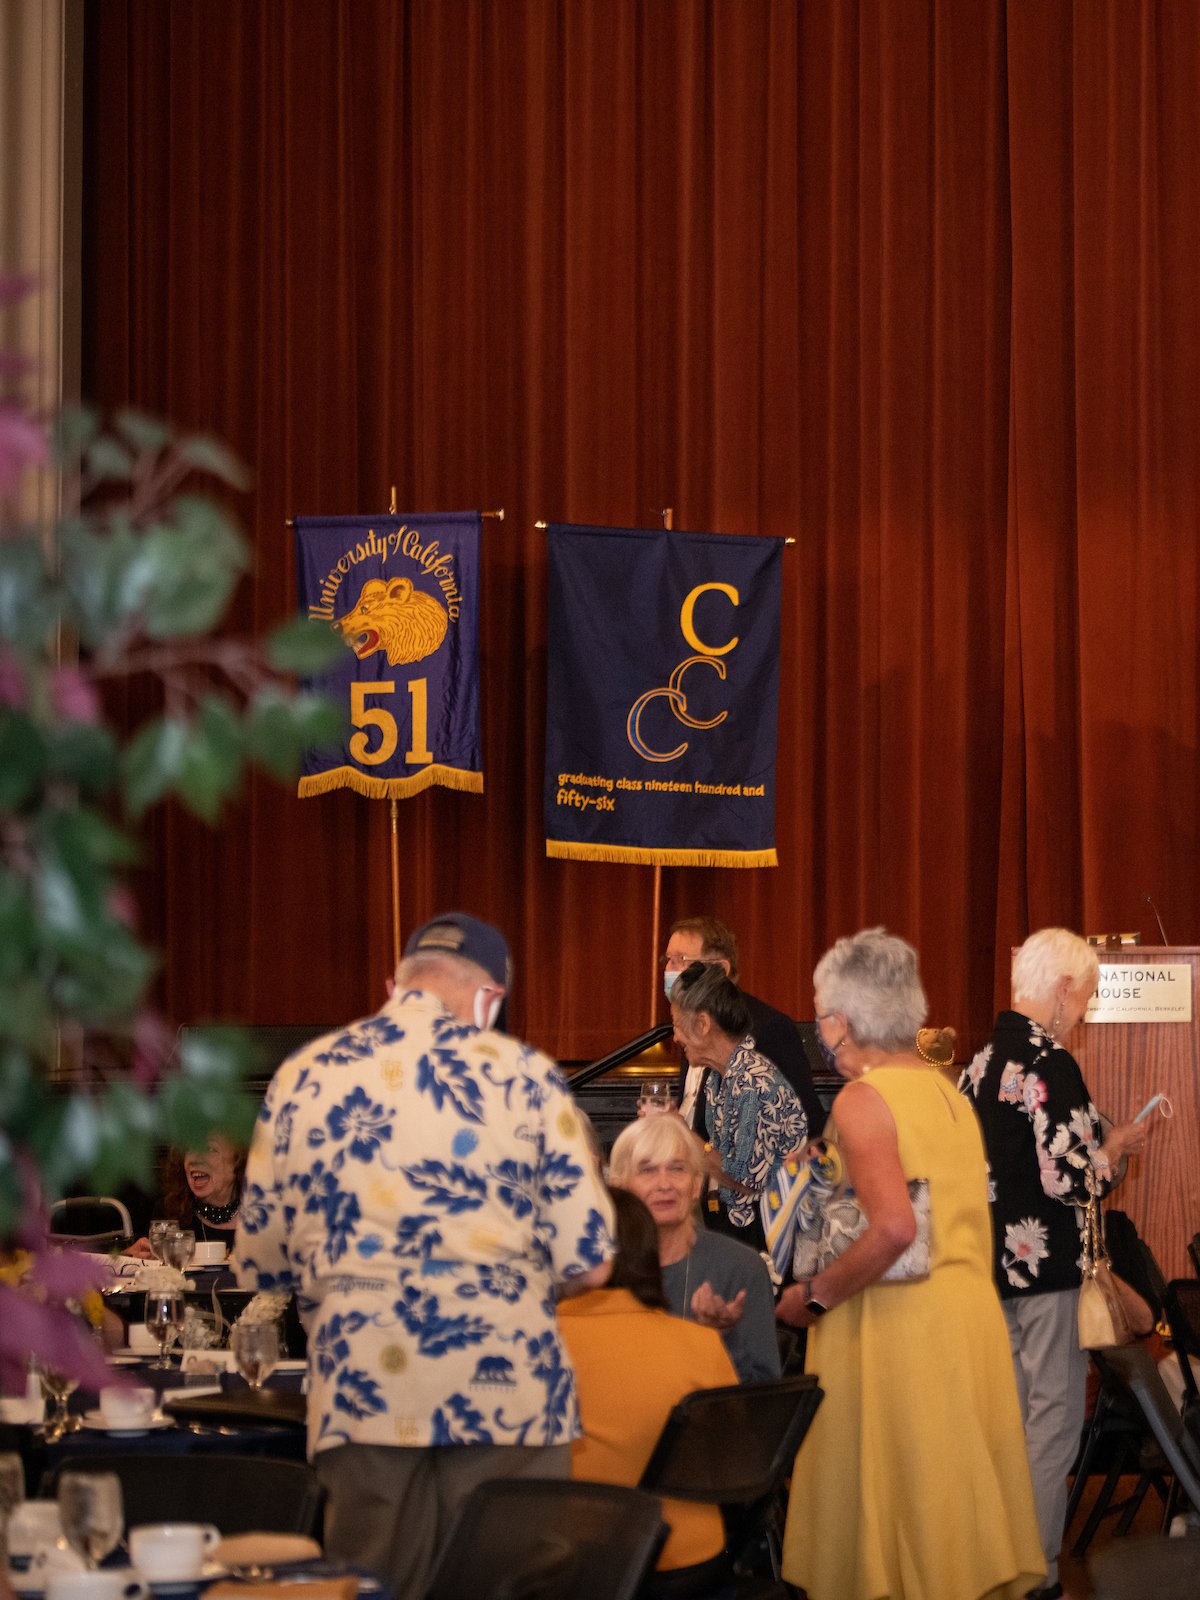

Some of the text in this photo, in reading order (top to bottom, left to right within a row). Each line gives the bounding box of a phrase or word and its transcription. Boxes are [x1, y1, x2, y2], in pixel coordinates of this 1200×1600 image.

[308, 525, 463, 623] University of California
[680, 582, 739, 656] C
[349, 677, 434, 765] 51
[627, 687, 687, 763] C
[669, 655, 728, 729] C
[556, 788, 615, 811] fifty-six
[557, 772, 765, 797] graduating class nineteen hundred and
